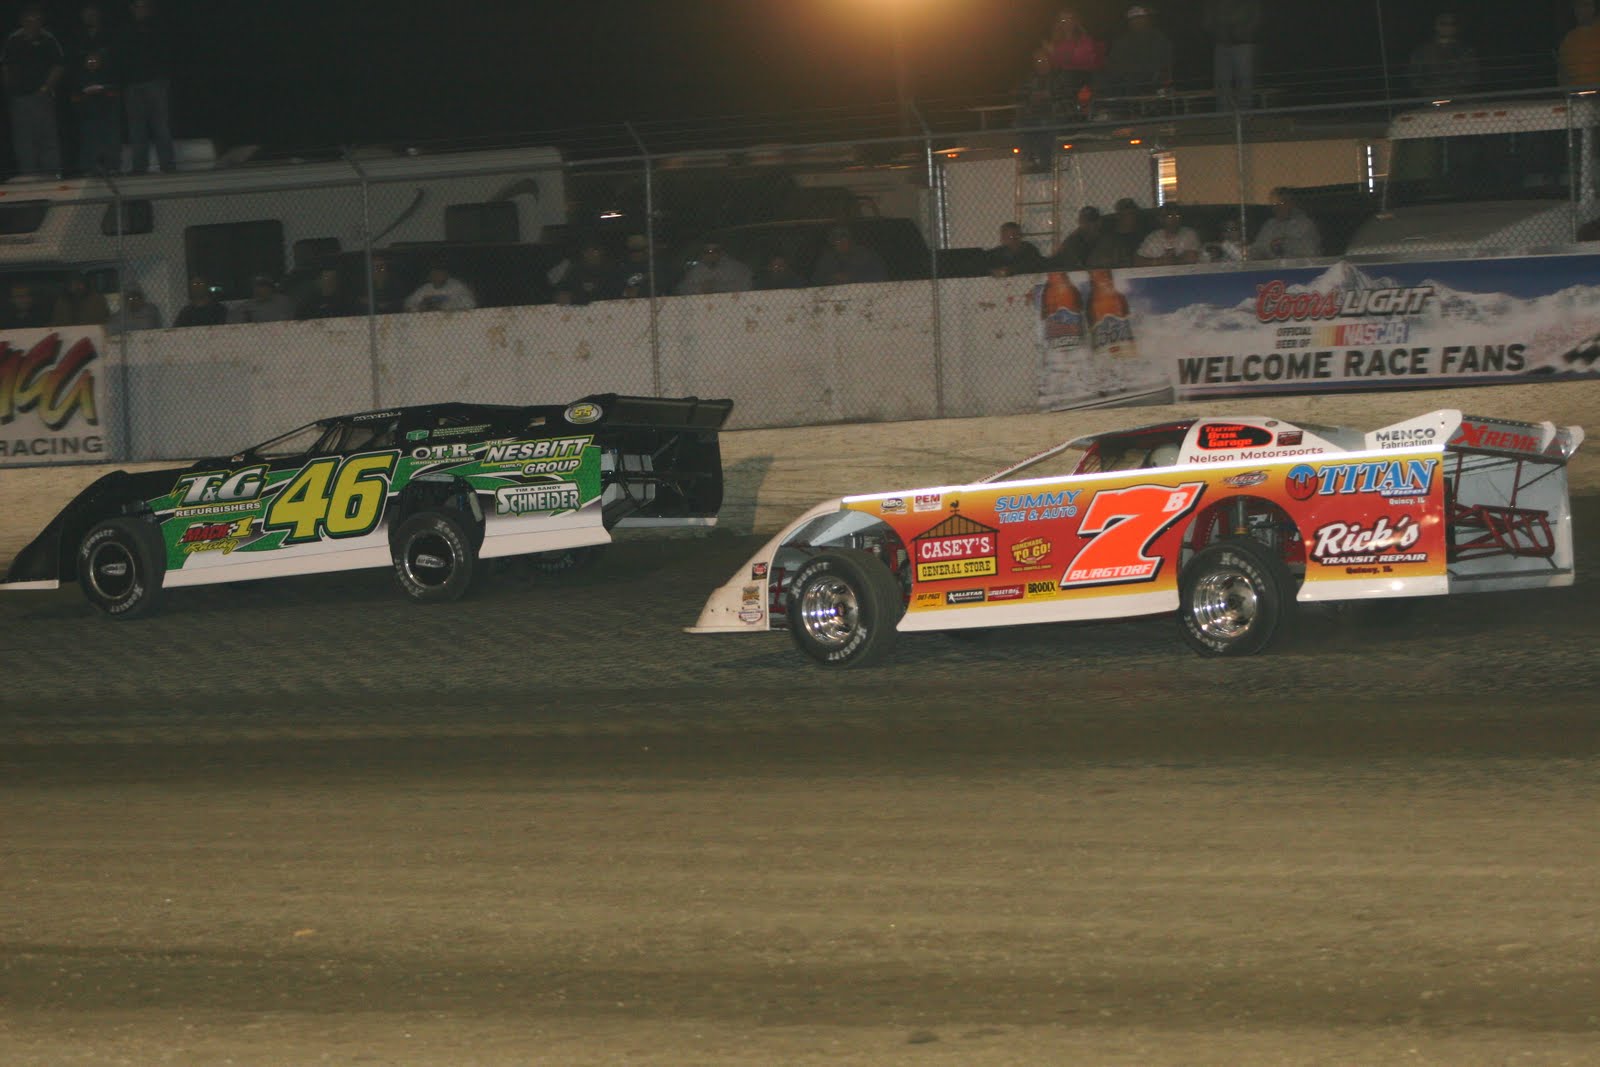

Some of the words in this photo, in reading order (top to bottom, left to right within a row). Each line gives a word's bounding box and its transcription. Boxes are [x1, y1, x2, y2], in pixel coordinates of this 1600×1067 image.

[1256, 280, 1338, 323] Coors
[1340, 286, 1434, 317] LIGHT
[1276, 327, 1313, 337] OFFICIAL
[1343, 323, 1410, 345] NASCAR
[1275, 340, 1297, 349] BEER
[1299, 339, 1312, 348] OF
[1177, 352, 1331, 385] WELCOME
[1343, 347, 1431, 377] RACE
[1440, 343, 1527, 373] FANS
[1375, 427, 1436, 442] MENCO
[1381, 438, 1433, 449] Fabrication
[484, 438, 590, 462] NESBITT
[1189, 454, 1235, 463] Nelson
[1240, 447, 1324, 460] Motorsports
[524, 460, 580, 475] GROUP
[1317, 458, 1437, 496] TITAN
[263, 450, 398, 543] 46
[496, 490, 581, 514] SCHNEIDER
[915, 494, 941, 504] PEM
[994, 489, 1084, 512] SUMMY
[175, 502, 261, 517] REFURBISHERS
[999, 511, 1026, 524] TIRE
[1028, 510, 1038, 521] &
[1040, 505, 1078, 519] AUTO
[1060, 482, 1207, 589] 7
[1313, 516, 1421, 558] Rick's
[921, 536, 991, 559] CASEY'S
[1013, 549, 1030, 562] TO
[1032, 542, 1052, 557] GO!
[922, 563, 962, 577] GENERAL
[964, 560, 991, 573] STORE
[1322, 555, 1377, 565] TRANSIT
[1378, 553, 1428, 563] REPAIR
[1069, 563, 1152, 580] BURGTORF
[1028, 581, 1056, 594] BRODIX
